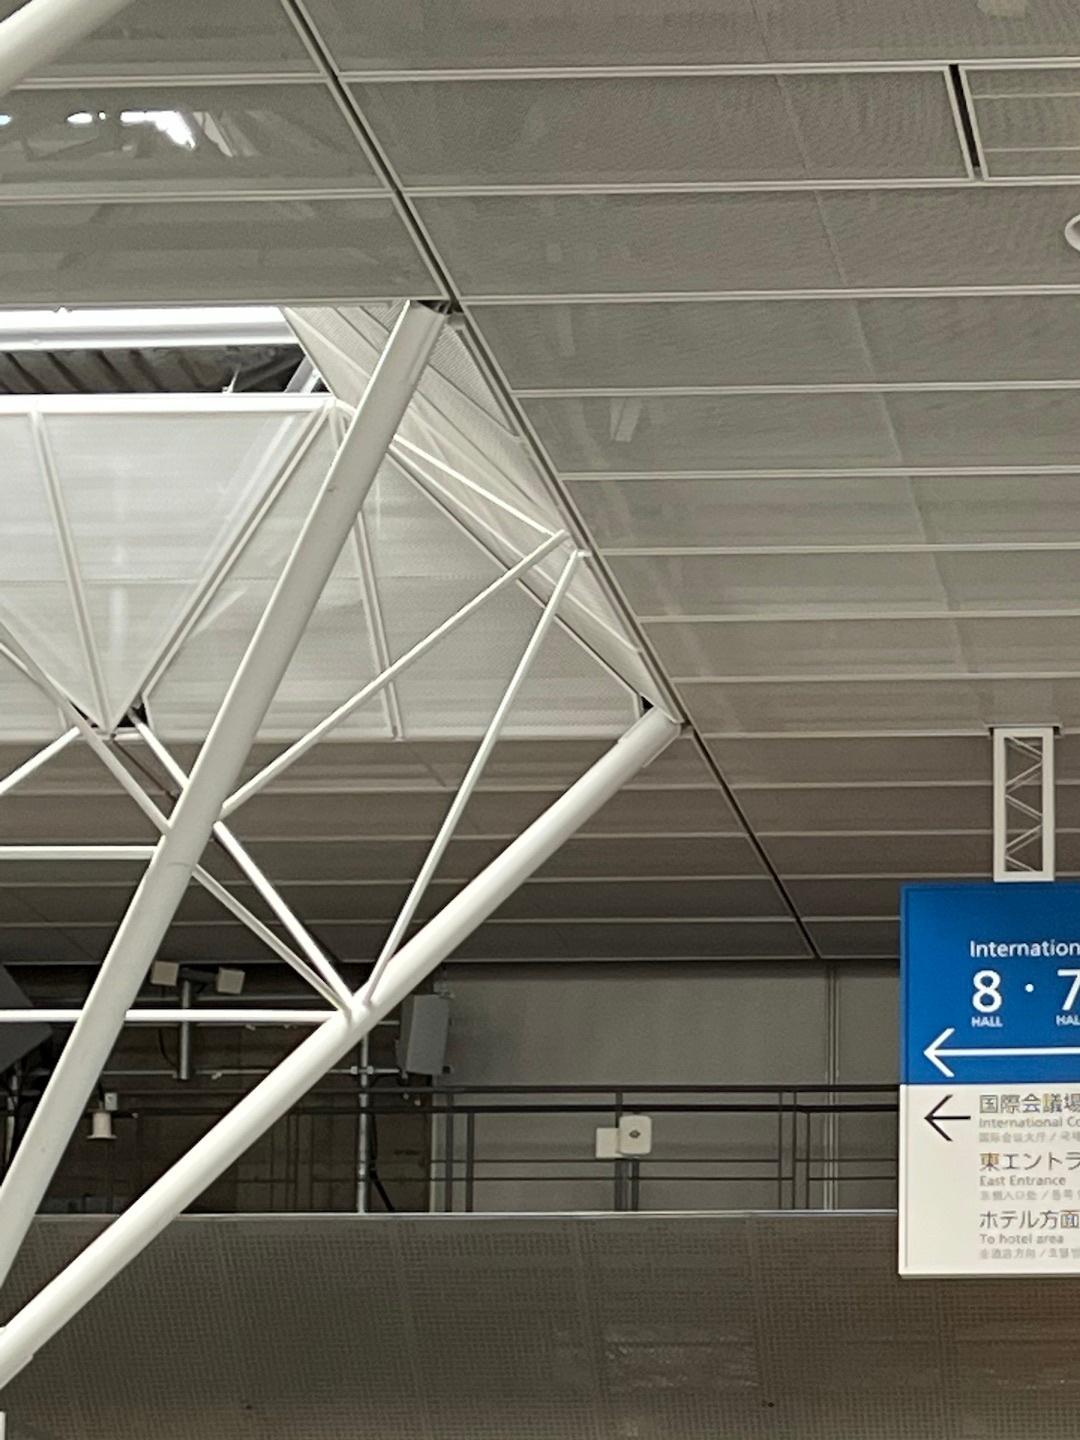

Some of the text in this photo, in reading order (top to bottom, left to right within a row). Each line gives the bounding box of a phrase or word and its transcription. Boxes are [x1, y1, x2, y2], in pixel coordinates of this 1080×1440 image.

[972, 969, 1002, 1013] 8
[971, 1015, 1003, 1028] HALL
[979, 1116, 1063, 1128] International
[979, 1175, 1067, 1187] East Entrance
[979, 1209, 1080, 1230] ホテル方面
[979, 1233, 1065, 1245] To hotel area
